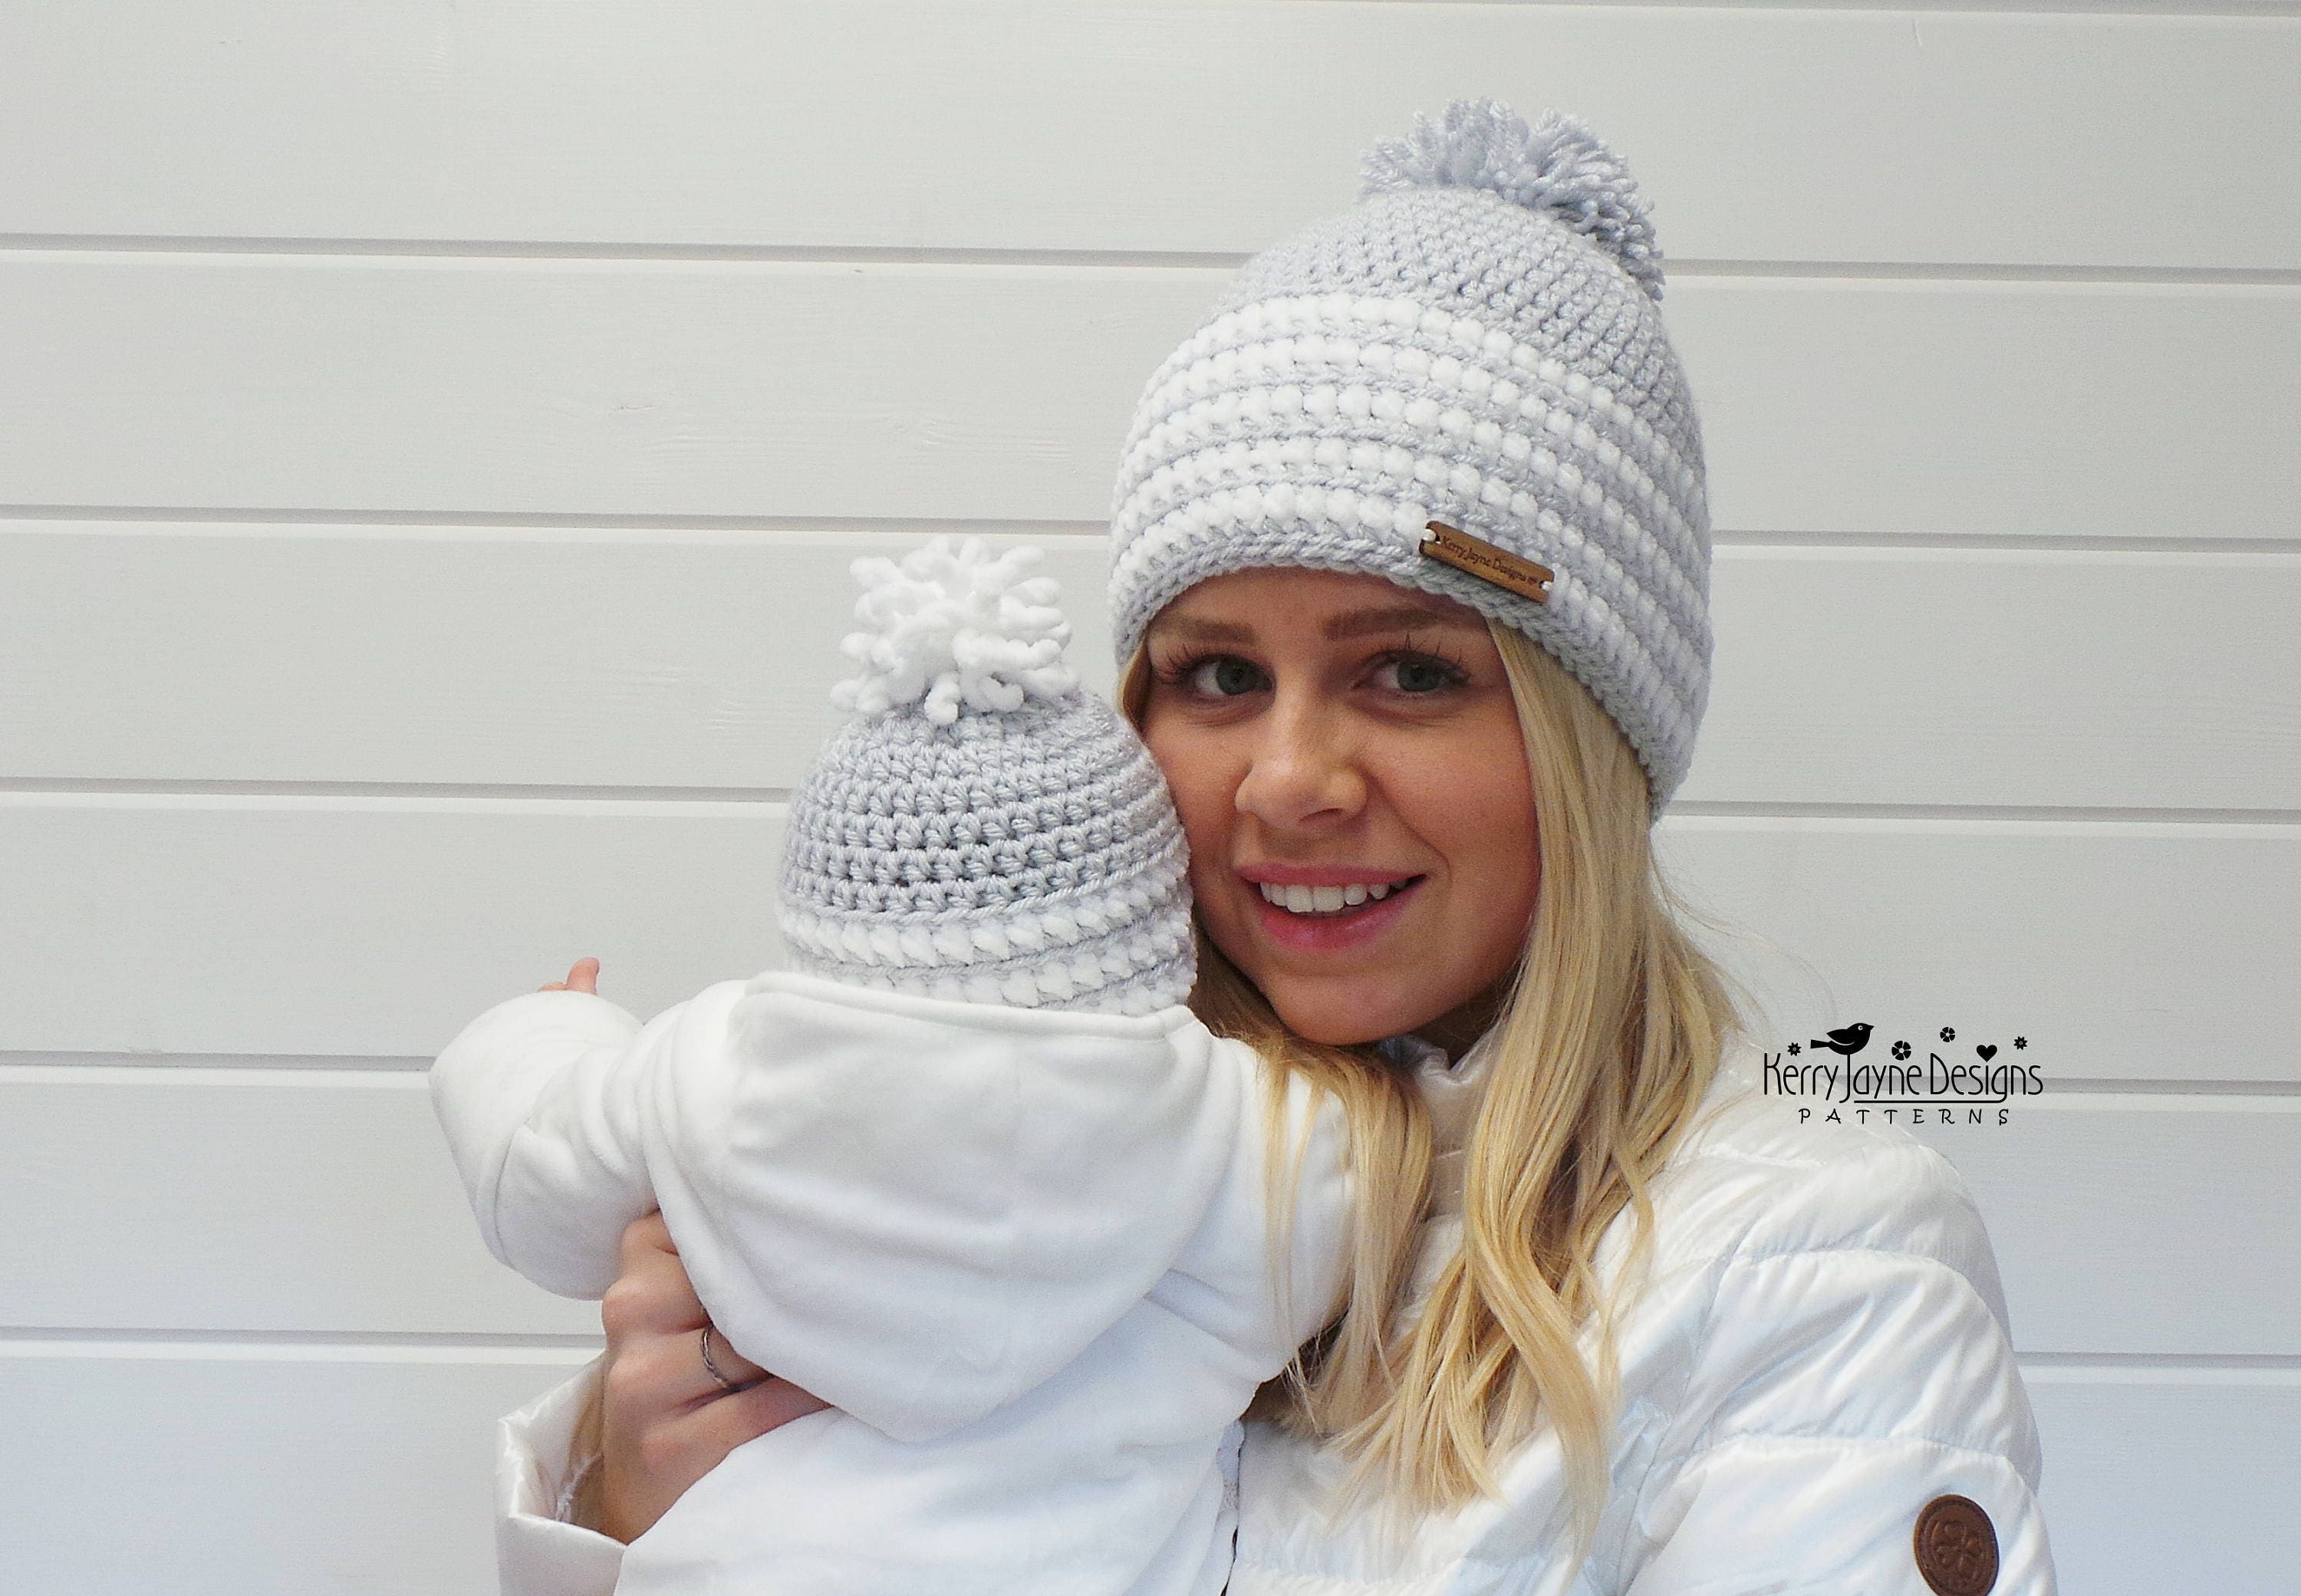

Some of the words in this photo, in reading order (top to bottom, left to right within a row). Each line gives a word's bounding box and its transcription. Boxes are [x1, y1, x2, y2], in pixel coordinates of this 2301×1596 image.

[1440, 536, 1466, 558] Kerry
[1464, 548, 1490, 566] Jayne
[1493, 558, 1526, 581] Designs
